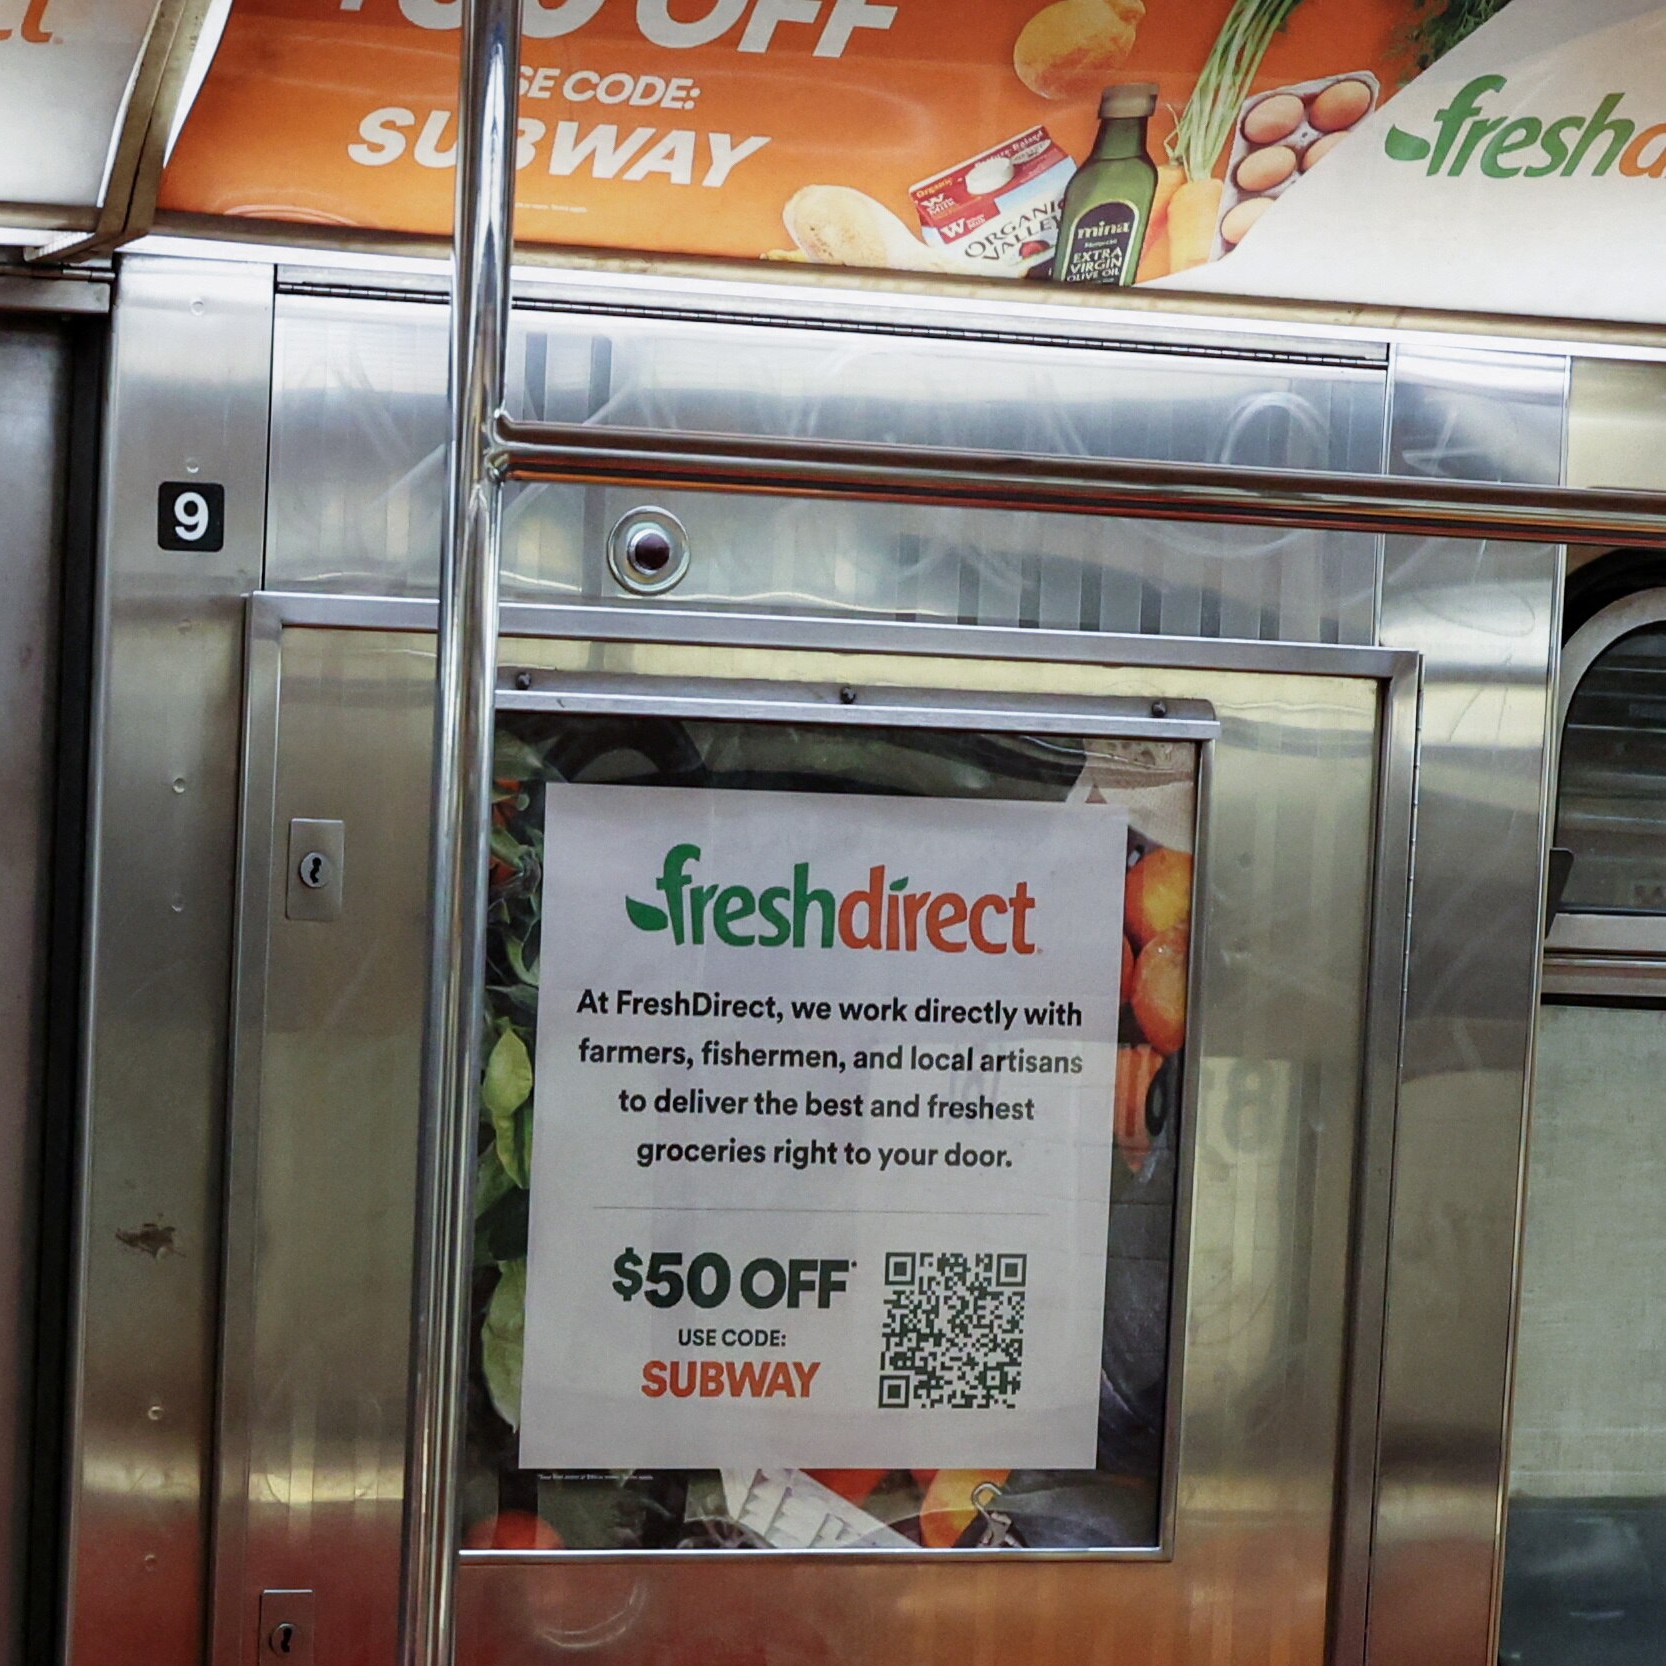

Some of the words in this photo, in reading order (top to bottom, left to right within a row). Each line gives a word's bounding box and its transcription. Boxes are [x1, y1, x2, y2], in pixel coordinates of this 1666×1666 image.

[517, 64, 561, 99] SE
[562, 69, 701, 109] CODE:
[1077, 220, 1130, 240] mina
[1069, 256, 1123, 274] VIRGIN
[1073, 247, 1123, 264] EXTRA
[1067, 270, 1099, 282] OLIVE
[1102, 267, 1120, 277] OIL
[174, 491, 209, 541] 9
[655, 843, 1037, 955] freshdirect
[577, 988, 609, 1015] At
[616, 990, 784, 1024] FreshDirect,
[791, 1001, 832, 1020] we
[839, 996, 908, 1022] work
[915, 998, 1018, 1031] directly
[1024, 1002, 1083, 1027] with
[578, 1036, 694, 1071] farmers,
[702, 1039, 846, 1074] fishermen,
[853, 1045, 903, 1070] and
[910, 1046, 974, 1072] local
[980, 1050, 1083, 1074] artisans
[618, 1090, 647, 1113] to
[654, 1088, 748, 1115] deliver
[755, 1091, 798, 1115] the
[805, 1091, 864, 1117] best
[871, 1093, 920, 1118] and
[927, 1094, 1035, 1121] freshest
[636, 1137, 766, 1168] groceries
[773, 1139, 838, 1171] right
[844, 1143, 872, 1166] to
[878, 1147, 939, 1172] your
[944, 1142, 1013, 1168] door.
[612, 1247, 731, 1309] $50
[678, 1328, 717, 1347] USE
[722, 1329, 787, 1347] CODE:
[641, 1360, 821, 1399] SUBWAY
